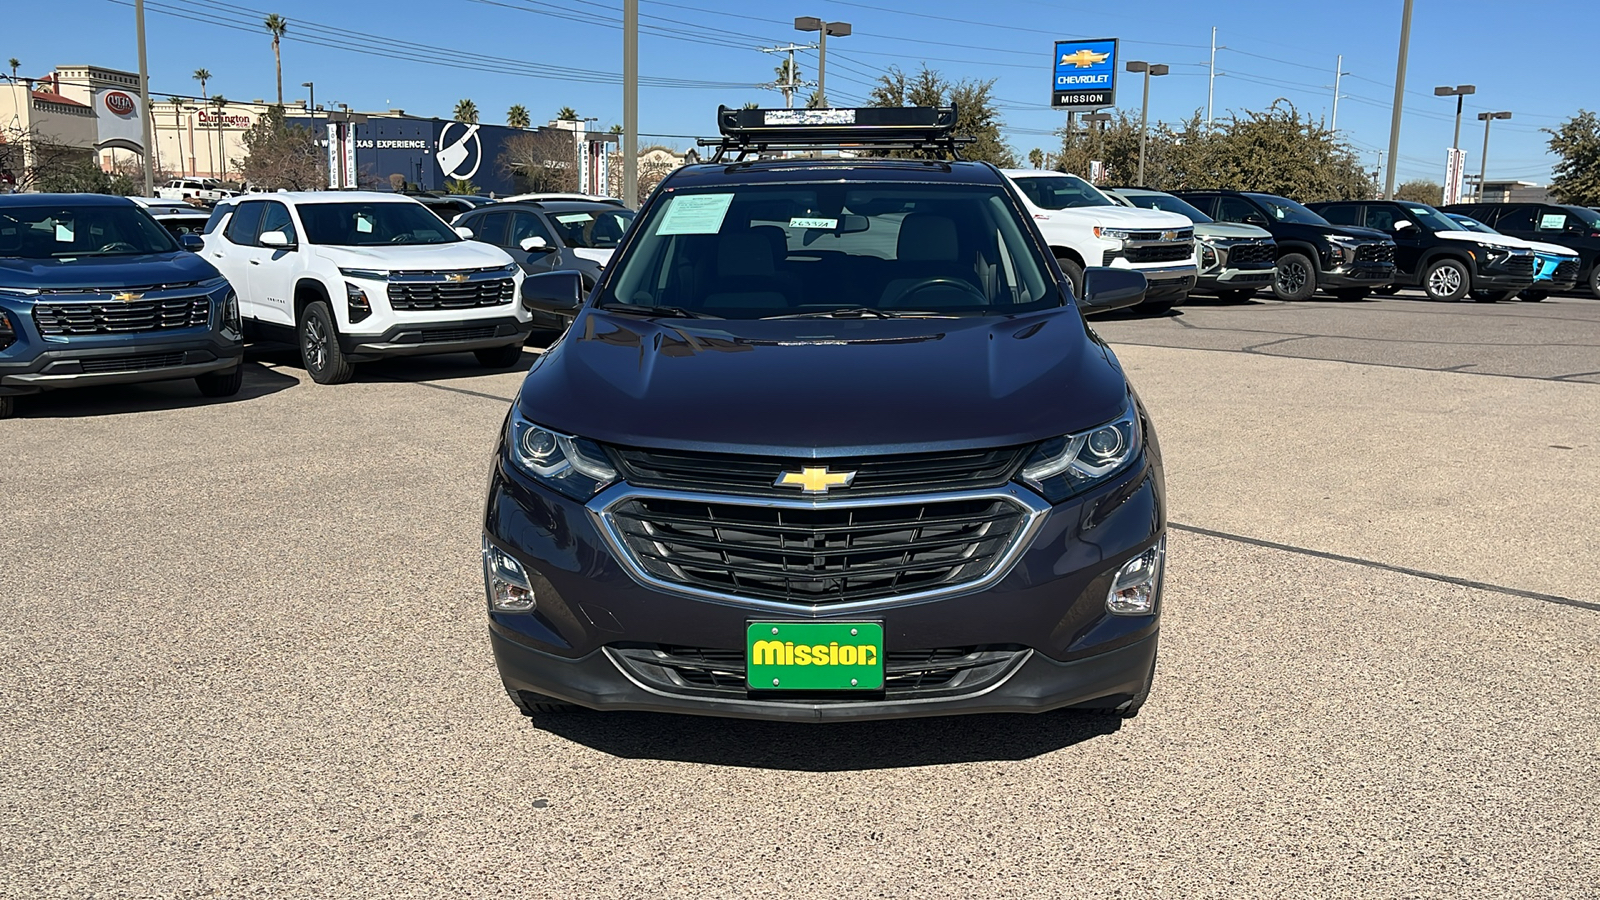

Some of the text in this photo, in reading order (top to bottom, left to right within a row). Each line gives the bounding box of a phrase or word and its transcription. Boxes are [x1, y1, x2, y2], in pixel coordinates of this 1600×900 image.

[1057, 75, 1109, 85] CHEVROLET
[1061, 94, 1103, 104] MISSION
[198, 111, 250, 126] Burington
[752, 640, 877, 666] Mission
